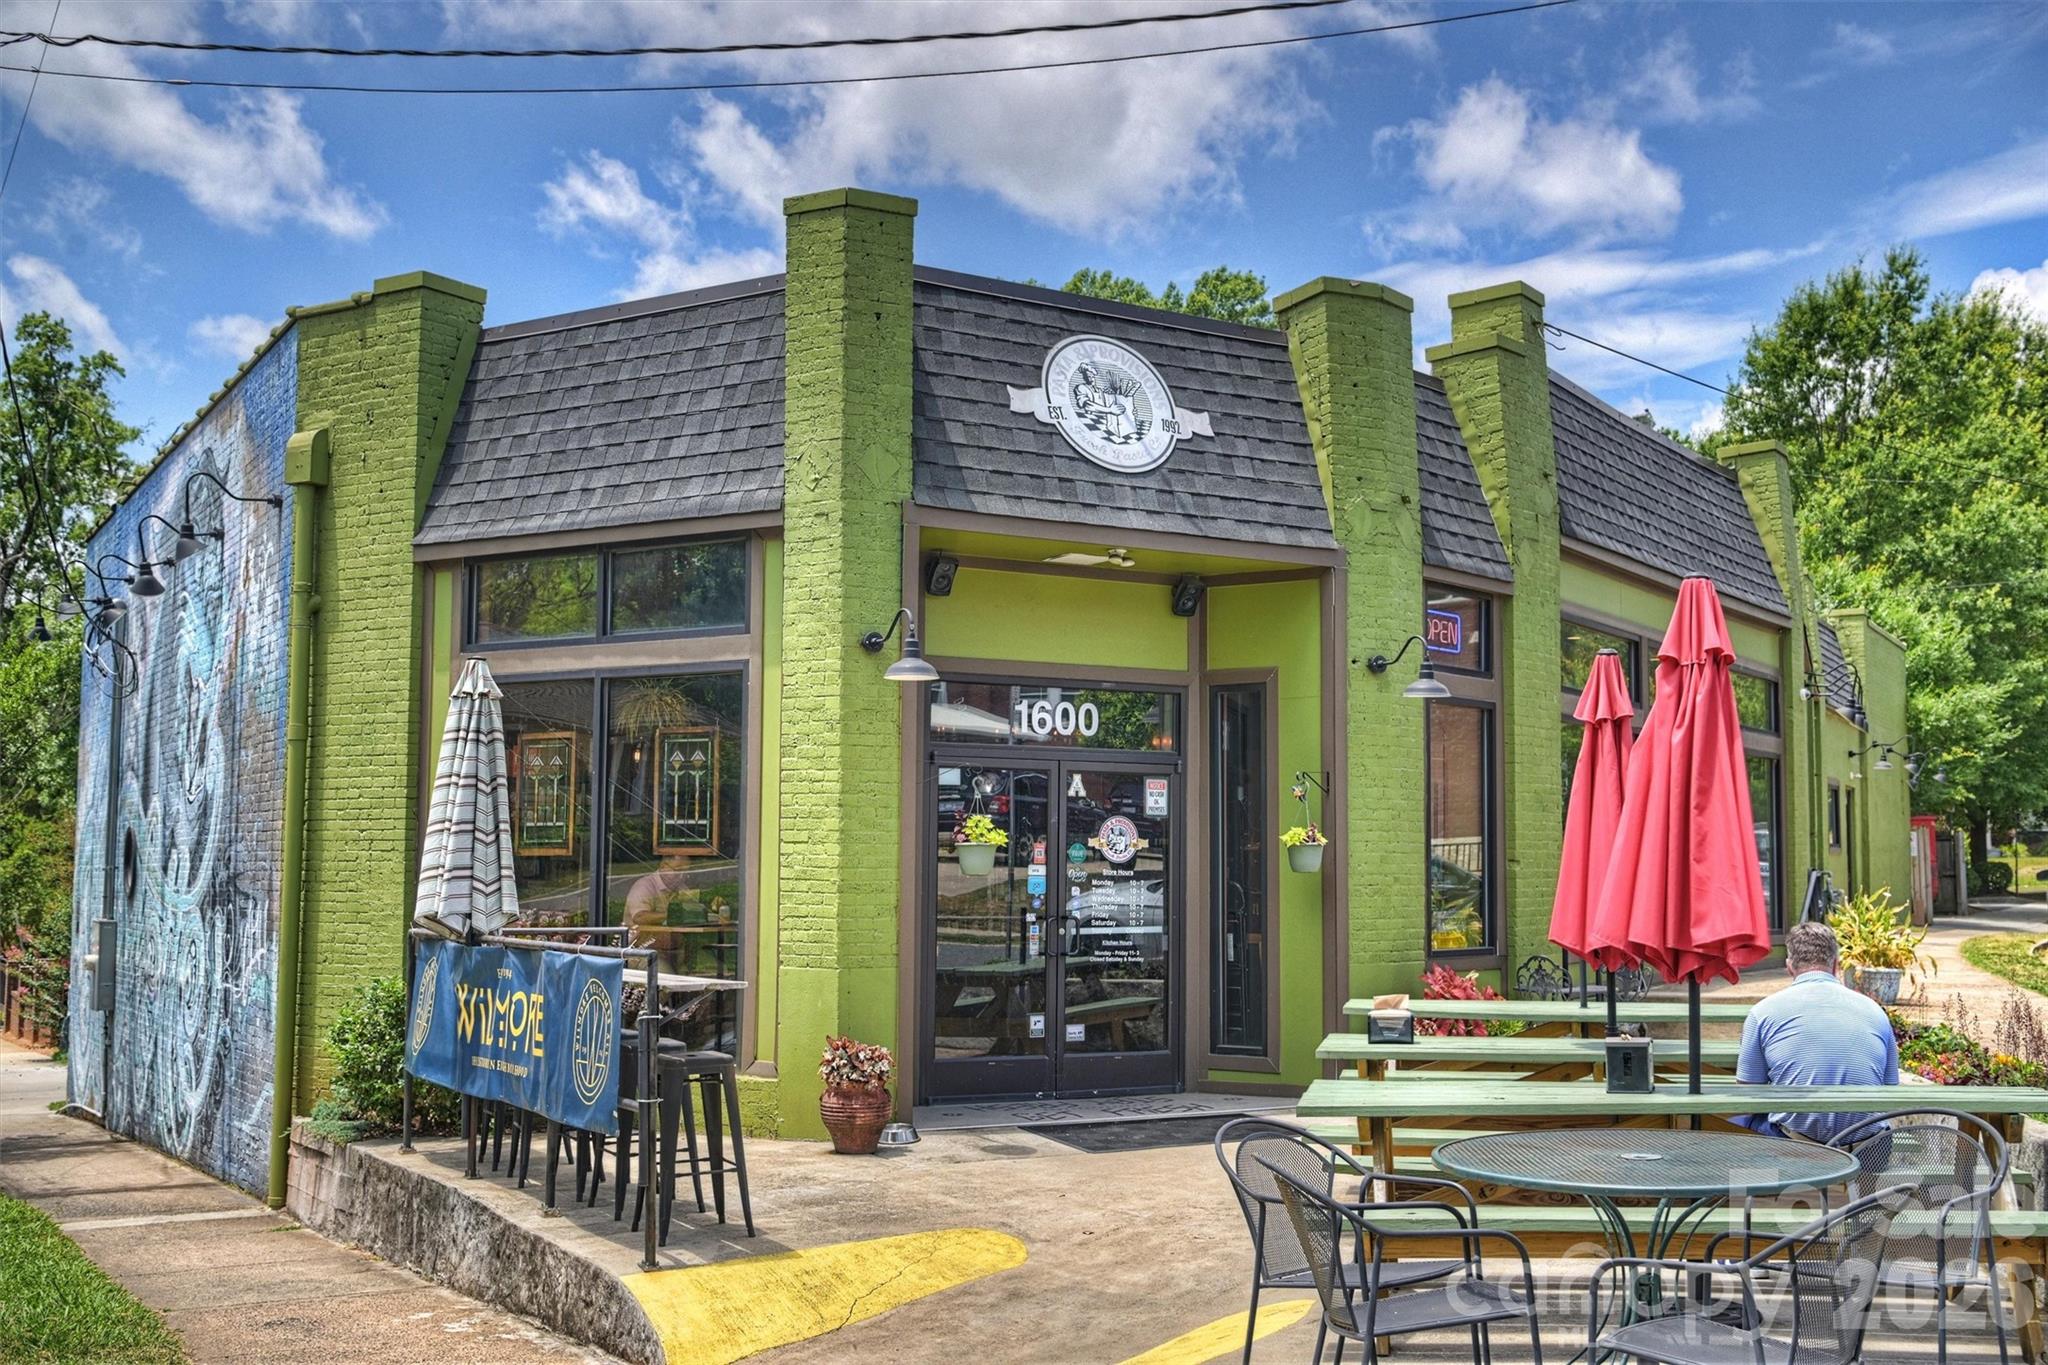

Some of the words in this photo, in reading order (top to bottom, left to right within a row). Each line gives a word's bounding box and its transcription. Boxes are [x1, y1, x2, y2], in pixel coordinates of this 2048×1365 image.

[1051, 355, 1076, 398] PASTA
[1089, 342, 1168, 410] PROVISIONS
[1048, 405, 1068, 421] EST.
[1161, 418, 1182, 435] 1992
[1014, 699, 1100, 737] 1600
[1067, 773, 1087, 797] A
[1068, 868, 1088, 881] Open
[455, 983, 545, 1058] WILMORE
[1011, 1110, 1083, 1123] GET
[1102, 1102, 1214, 1117] FRESH
